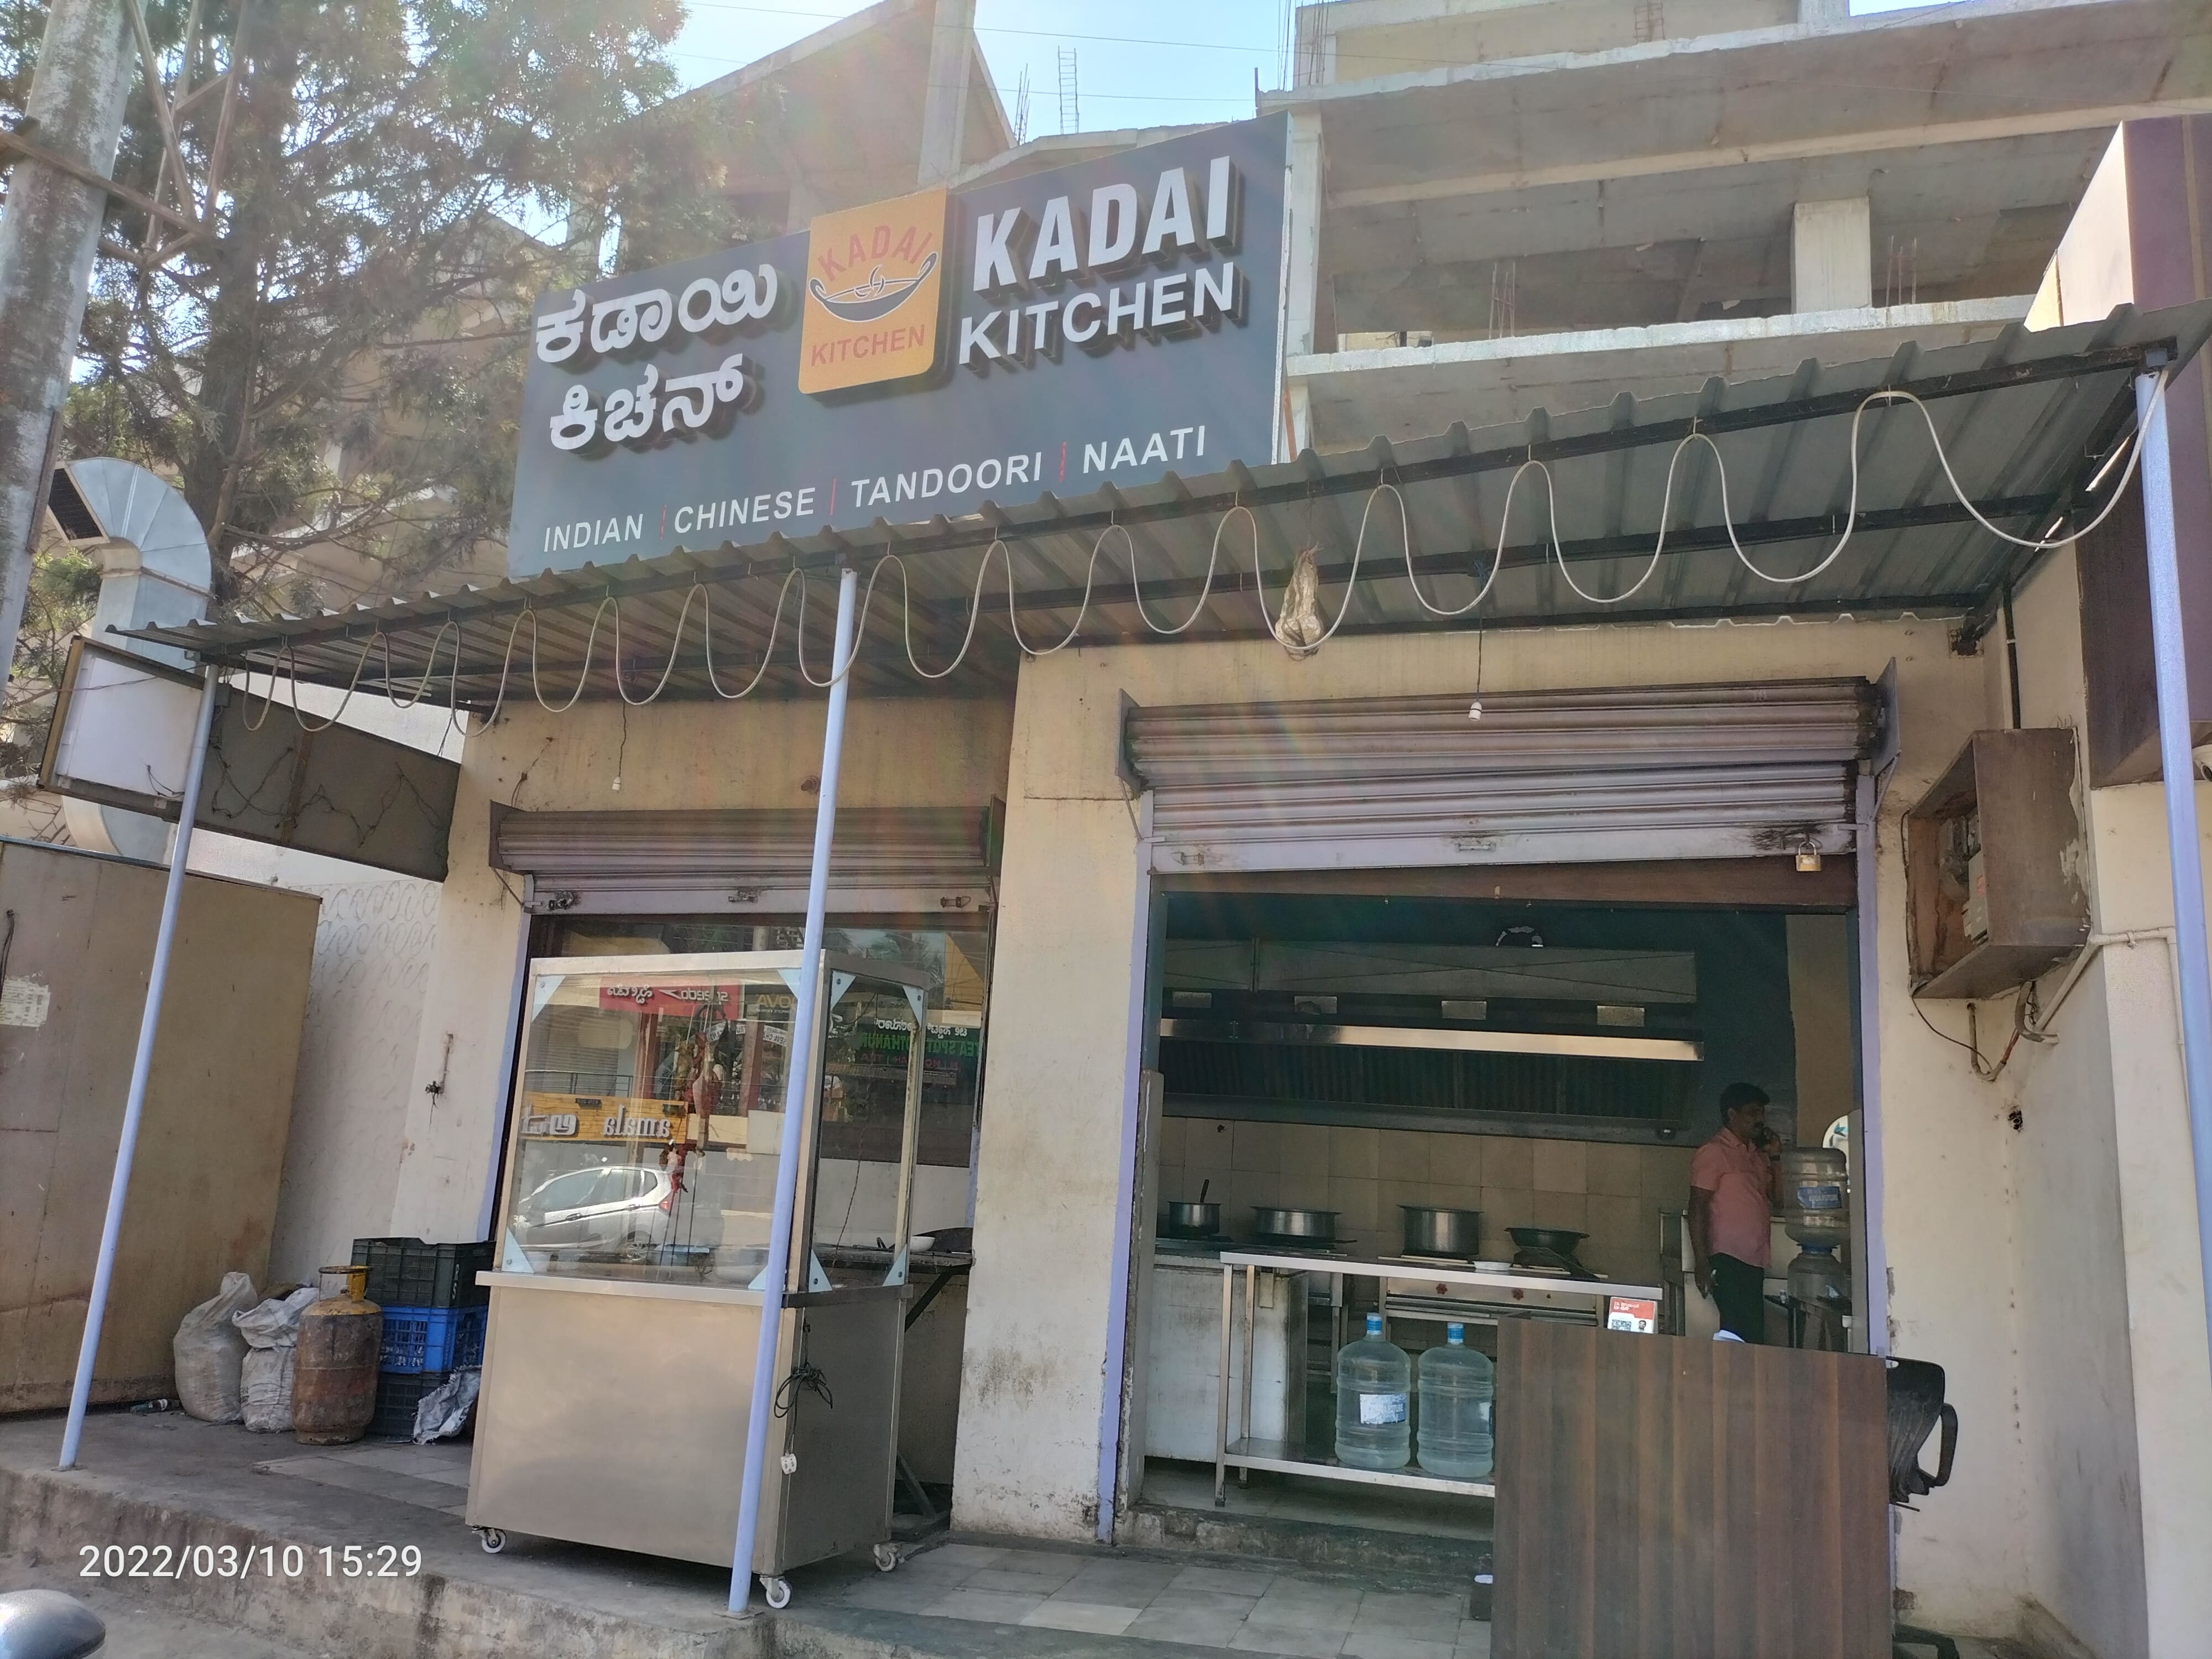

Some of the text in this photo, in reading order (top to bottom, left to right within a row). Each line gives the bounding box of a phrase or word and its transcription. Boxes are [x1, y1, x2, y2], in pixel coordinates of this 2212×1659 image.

[818, 226, 933, 281] KADAI
[973, 155, 1230, 292] KADAI
[536, 264, 778, 363] ಕಡಾಯಿ
[811, 324, 925, 367] KITCHEN
[958, 262, 1234, 365] KITCHEN
[544, 425, 1206, 552] INDIAN CHINESE TANDOORI NAATI
